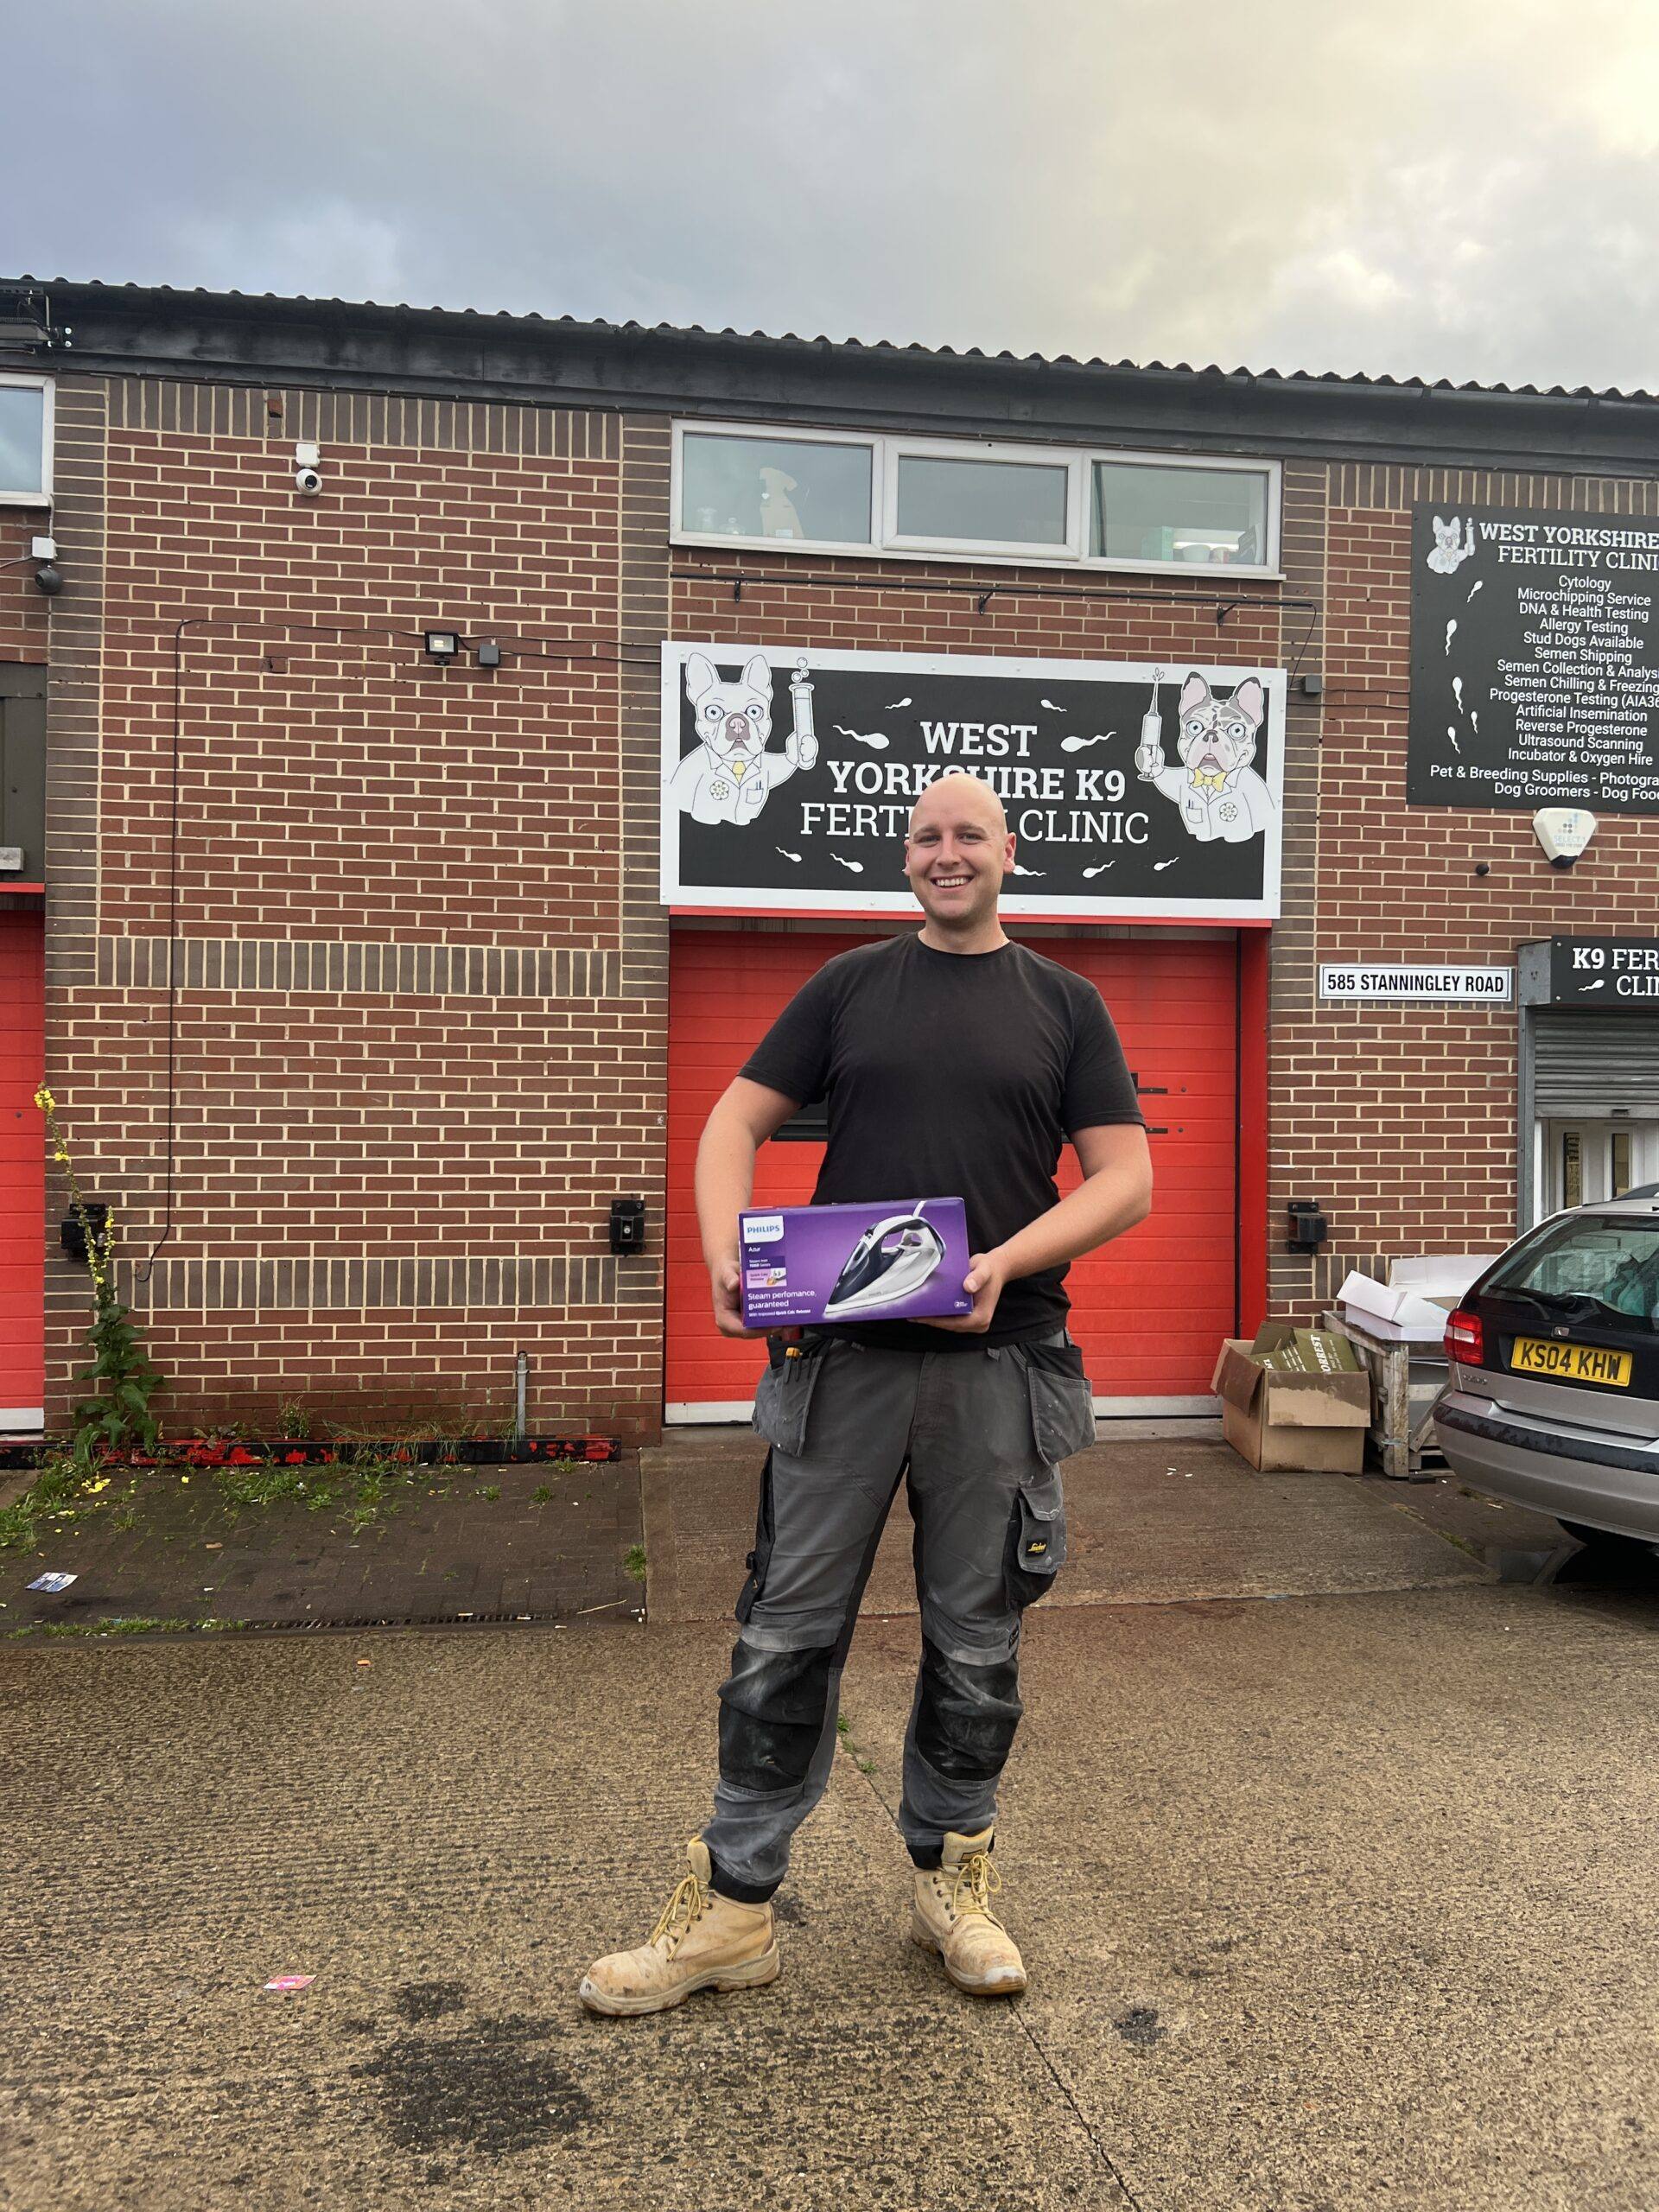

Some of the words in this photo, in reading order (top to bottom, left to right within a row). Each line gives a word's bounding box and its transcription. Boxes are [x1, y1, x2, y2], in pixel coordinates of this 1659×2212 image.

[1479, 522, 1538, 543] WEST
[1543, 526, 1659, 550] YORKSHIRE
[1498, 545, 1600, 568] FERTILITY
[1559, 575, 1611, 592] Cytology
[1517, 588, 1605, 607] Microchipping
[1607, 593, 1651, 606] Service
[1520, 603, 1547, 615] DNA
[1550, 604, 1560, 616] &
[1563, 605, 1602, 618] Health
[1605, 607, 1649, 623] Testing
[1540, 618, 1581, 633] Allergy
[1584, 620, 1629, 636] Testing
[1523, 632, 1551, 645] Stud
[1555, 633, 1586, 649] Dogs
[1589, 635, 1643, 649] Available
[1535, 647, 1577, 661] Semen
[1580, 649, 1632, 664] Shipping
[1497, 660, 1539, 673] Semen
[1542, 662, 1603, 676] Collection
[1607, 665, 1615, 677] &
[1504, 675, 1547, 688] Semen
[1550, 677, 1595, 693] Chilling
[1599, 679, 1606, 691] &
[1610, 680, 1659, 696] Freezing
[1491, 689, 1571, 707] Progesterone
[1574, 692, 1618, 708] Testing
[1516, 705, 1567, 719] Artificial
[1570, 708, 1648, 721] Insemination
[1516, 719, 1564, 733] Reverse
[1567, 721, 1648, 737] Progesterone
[920, 721, 1038, 758] WEST
[1518, 734, 1584, 747] Ultrasound
[1587, 736, 1643, 753] Scanning
[1509, 748, 1566, 762] Incubator
[1569, 751, 1578, 763] &
[1581, 752, 1624, 767] Oxygen
[1629, 753, 1653, 766] Hire
[1430, 765, 1452, 778] Pet
[1456, 766, 1465, 778] &
[1470, 766, 1528, 784] Breeding
[1532, 770, 1588, 786] Supplies
[1076, 769, 1126, 802] K9
[1495, 782, 1521, 798] Dog
[1525, 783, 1591, 798] Groomers
[1602, 786, 1628, 802] Dog
[1019, 810, 1149, 844] CLINIC
[1573, 948, 1605, 969] K9
[1327, 975, 1356, 992] 585
[1360, 975, 1460, 992] STANNINGLEY
[1465, 976, 1503, 994] ROAD
[748, 1300, 789, 1310] guaranteed
[1310, 1334, 1332, 1375] ORREST
[1520, 1340, 1573, 1372] KS04
[1578, 1349, 1621, 1380] KHW
